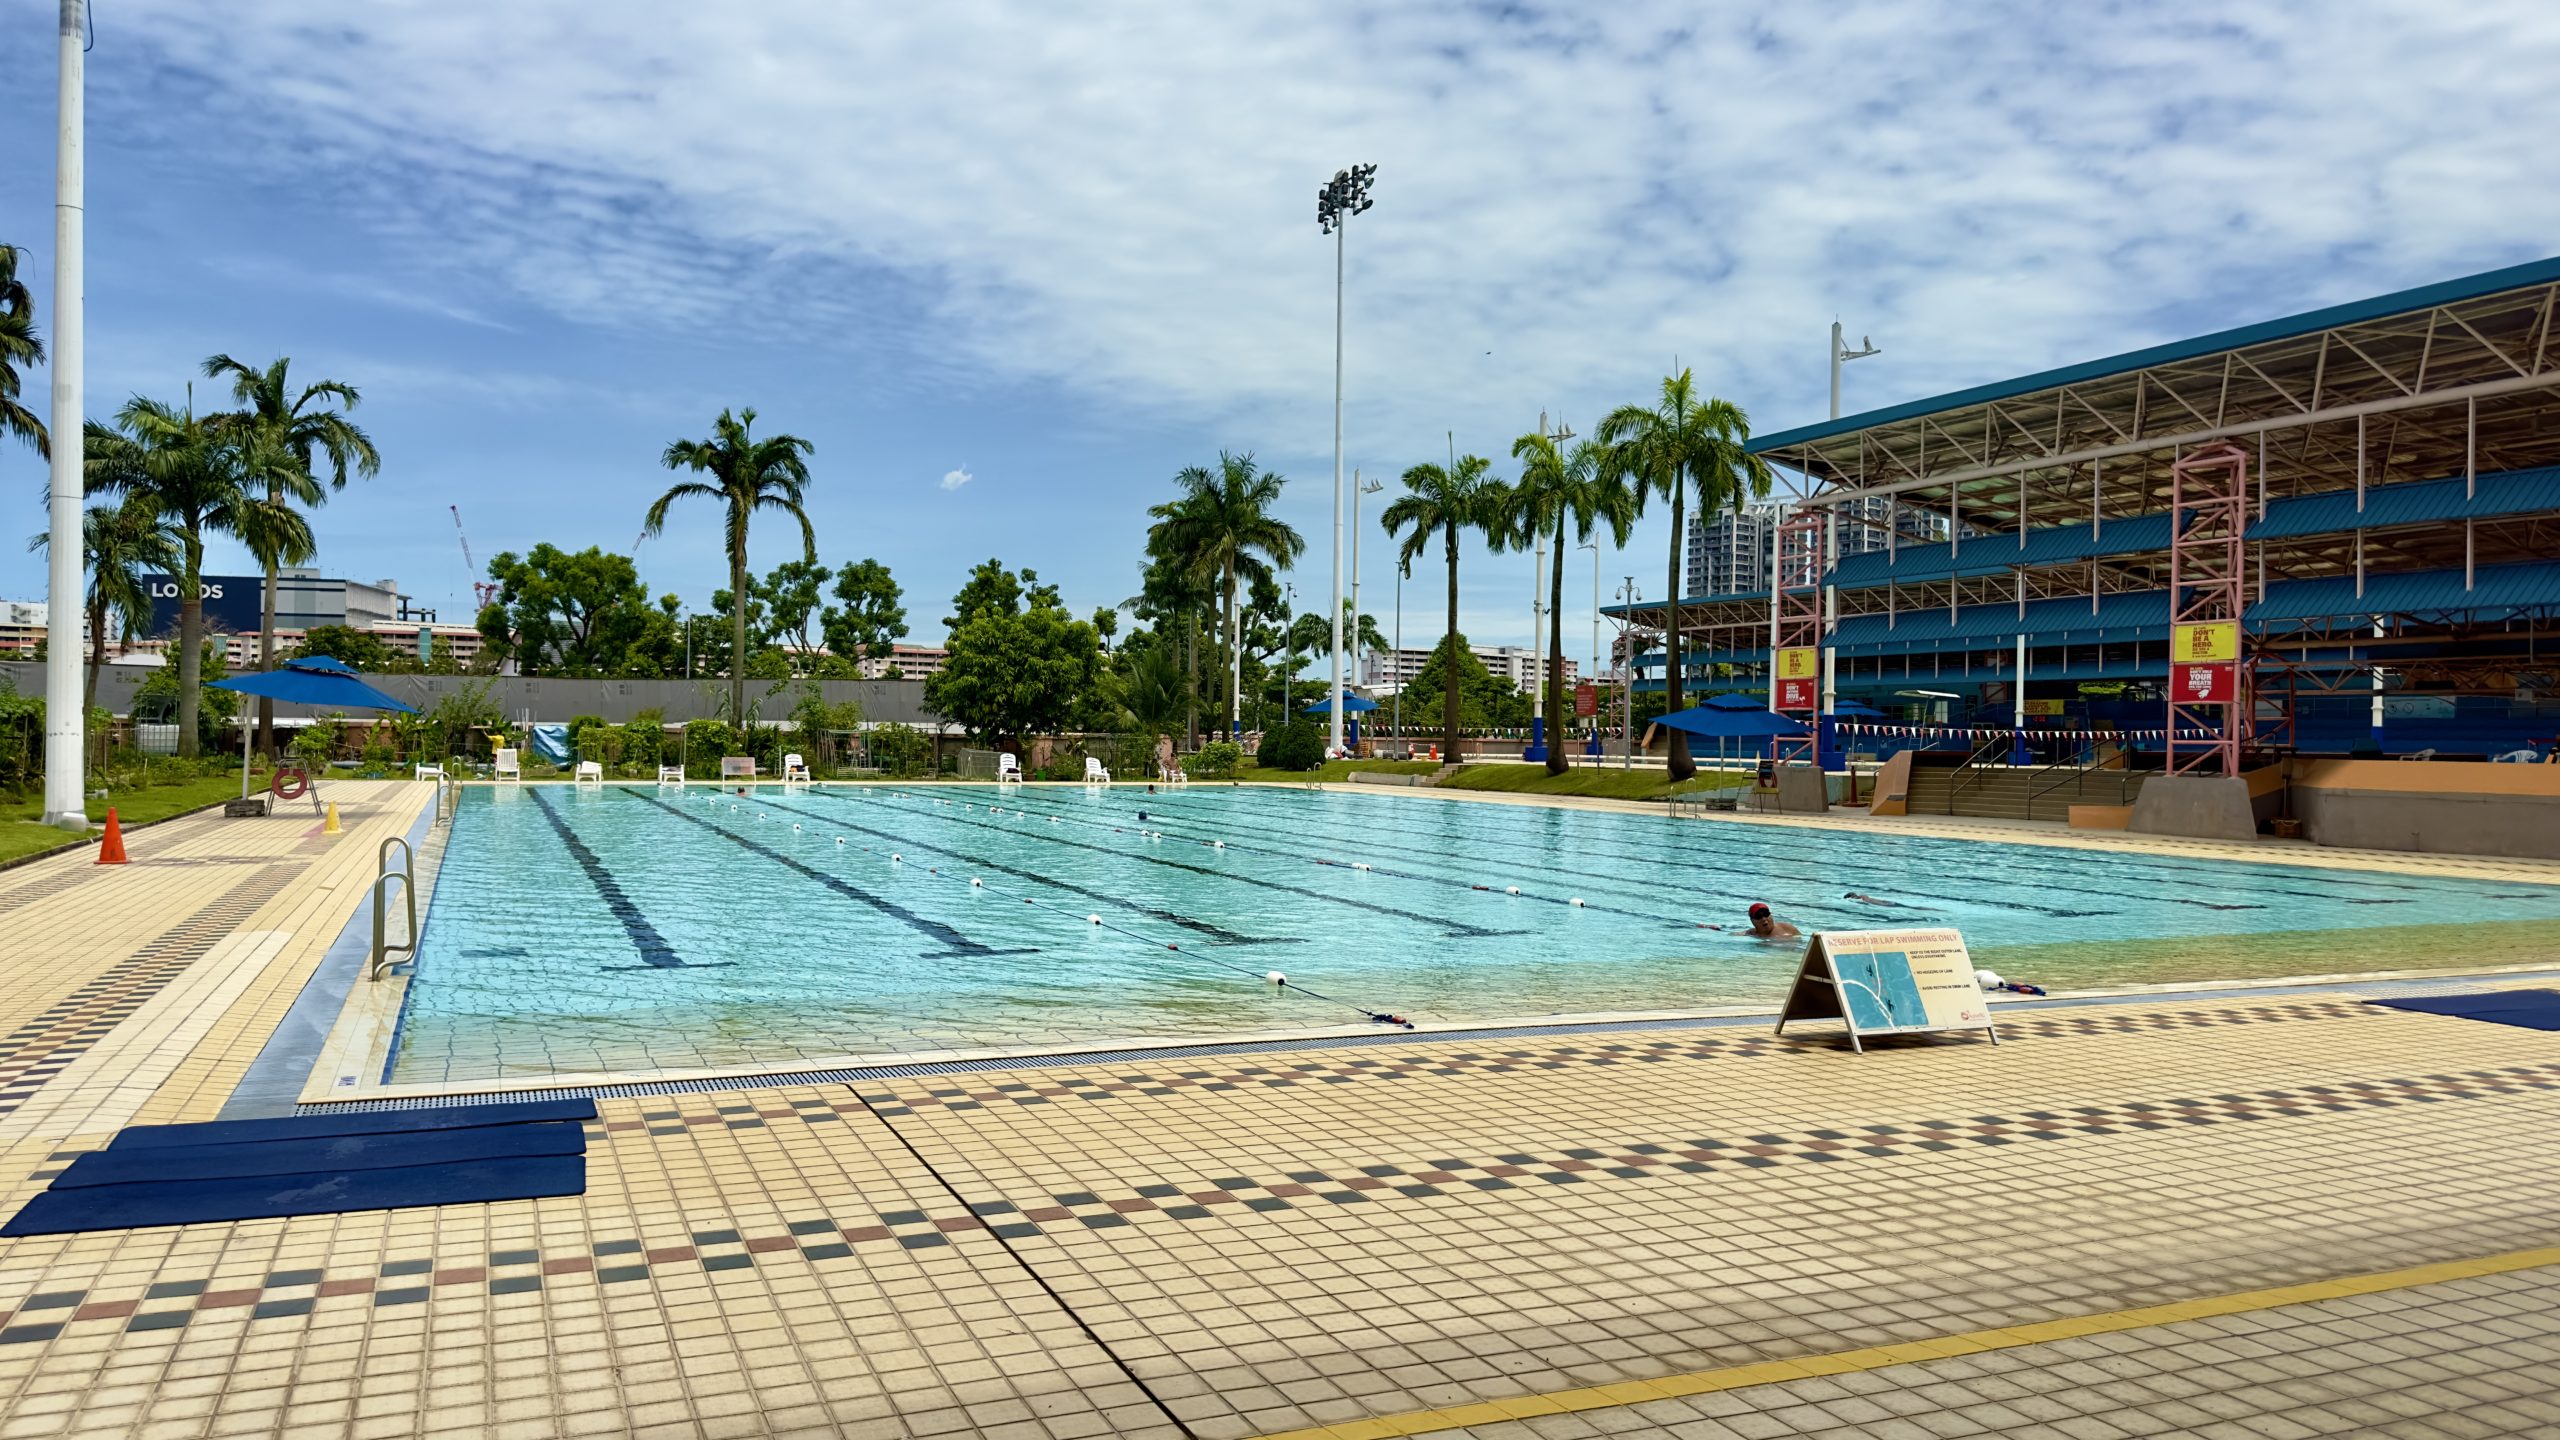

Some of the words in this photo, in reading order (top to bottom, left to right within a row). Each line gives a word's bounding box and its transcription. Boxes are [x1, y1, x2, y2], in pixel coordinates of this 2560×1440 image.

[151, 583, 224, 599] LOOS
[1863, 936, 1878, 945] FOR
[1880, 936, 1894, 945] LAP
[1896, 935, 1938, 944] SWIMMING
[1939, 934, 1958, 942] ONLY
